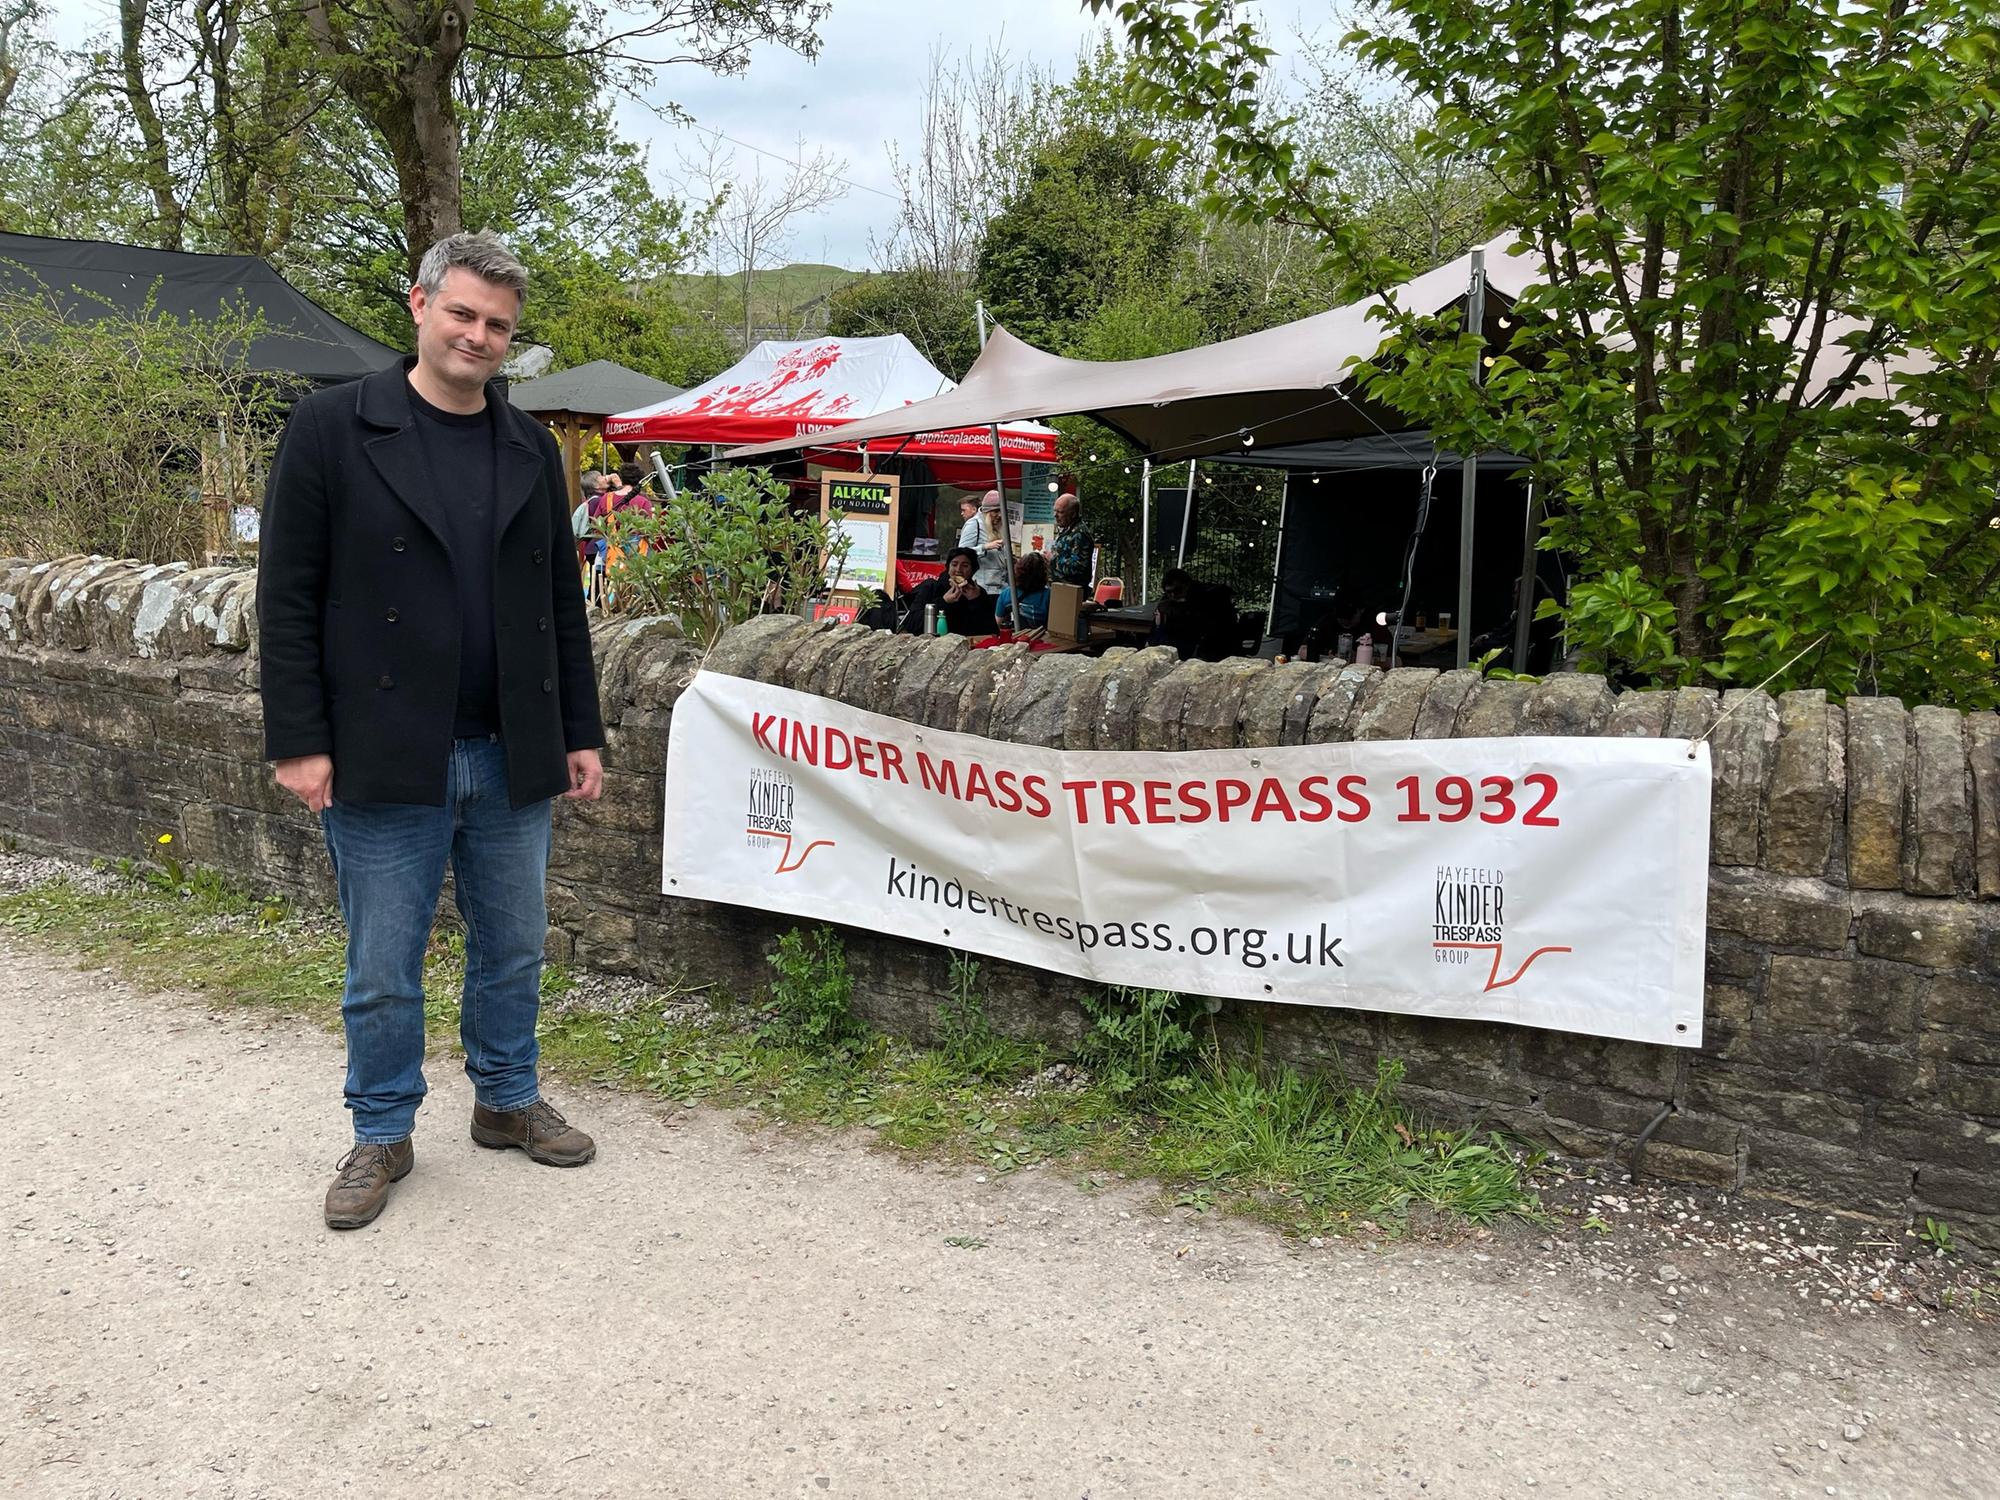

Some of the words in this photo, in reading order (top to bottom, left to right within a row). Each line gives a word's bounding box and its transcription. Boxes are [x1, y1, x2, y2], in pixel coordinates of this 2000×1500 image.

[832, 485, 885, 501] ALPKIT
[750, 768, 794, 785] HAYFIELD
[752, 712, 909, 785] KINDER
[916, 751, 1051, 818] MASS
[1062, 775, 1371, 825] TRESPASS
[1395, 773, 1559, 828] 1932
[749, 778, 794, 820] KINDER
[747, 814, 792, 833] TRESPASS
[747, 834, 771, 848] GROUP
[1437, 865, 1504, 885] HAYFIELD
[1436, 879, 1504, 926] KINDER
[886, 857, 1344, 968] kindertrespass.org.uk
[1432, 924, 1502, 942] TRESPASS
[1435, 948, 1469, 964] GROUP
